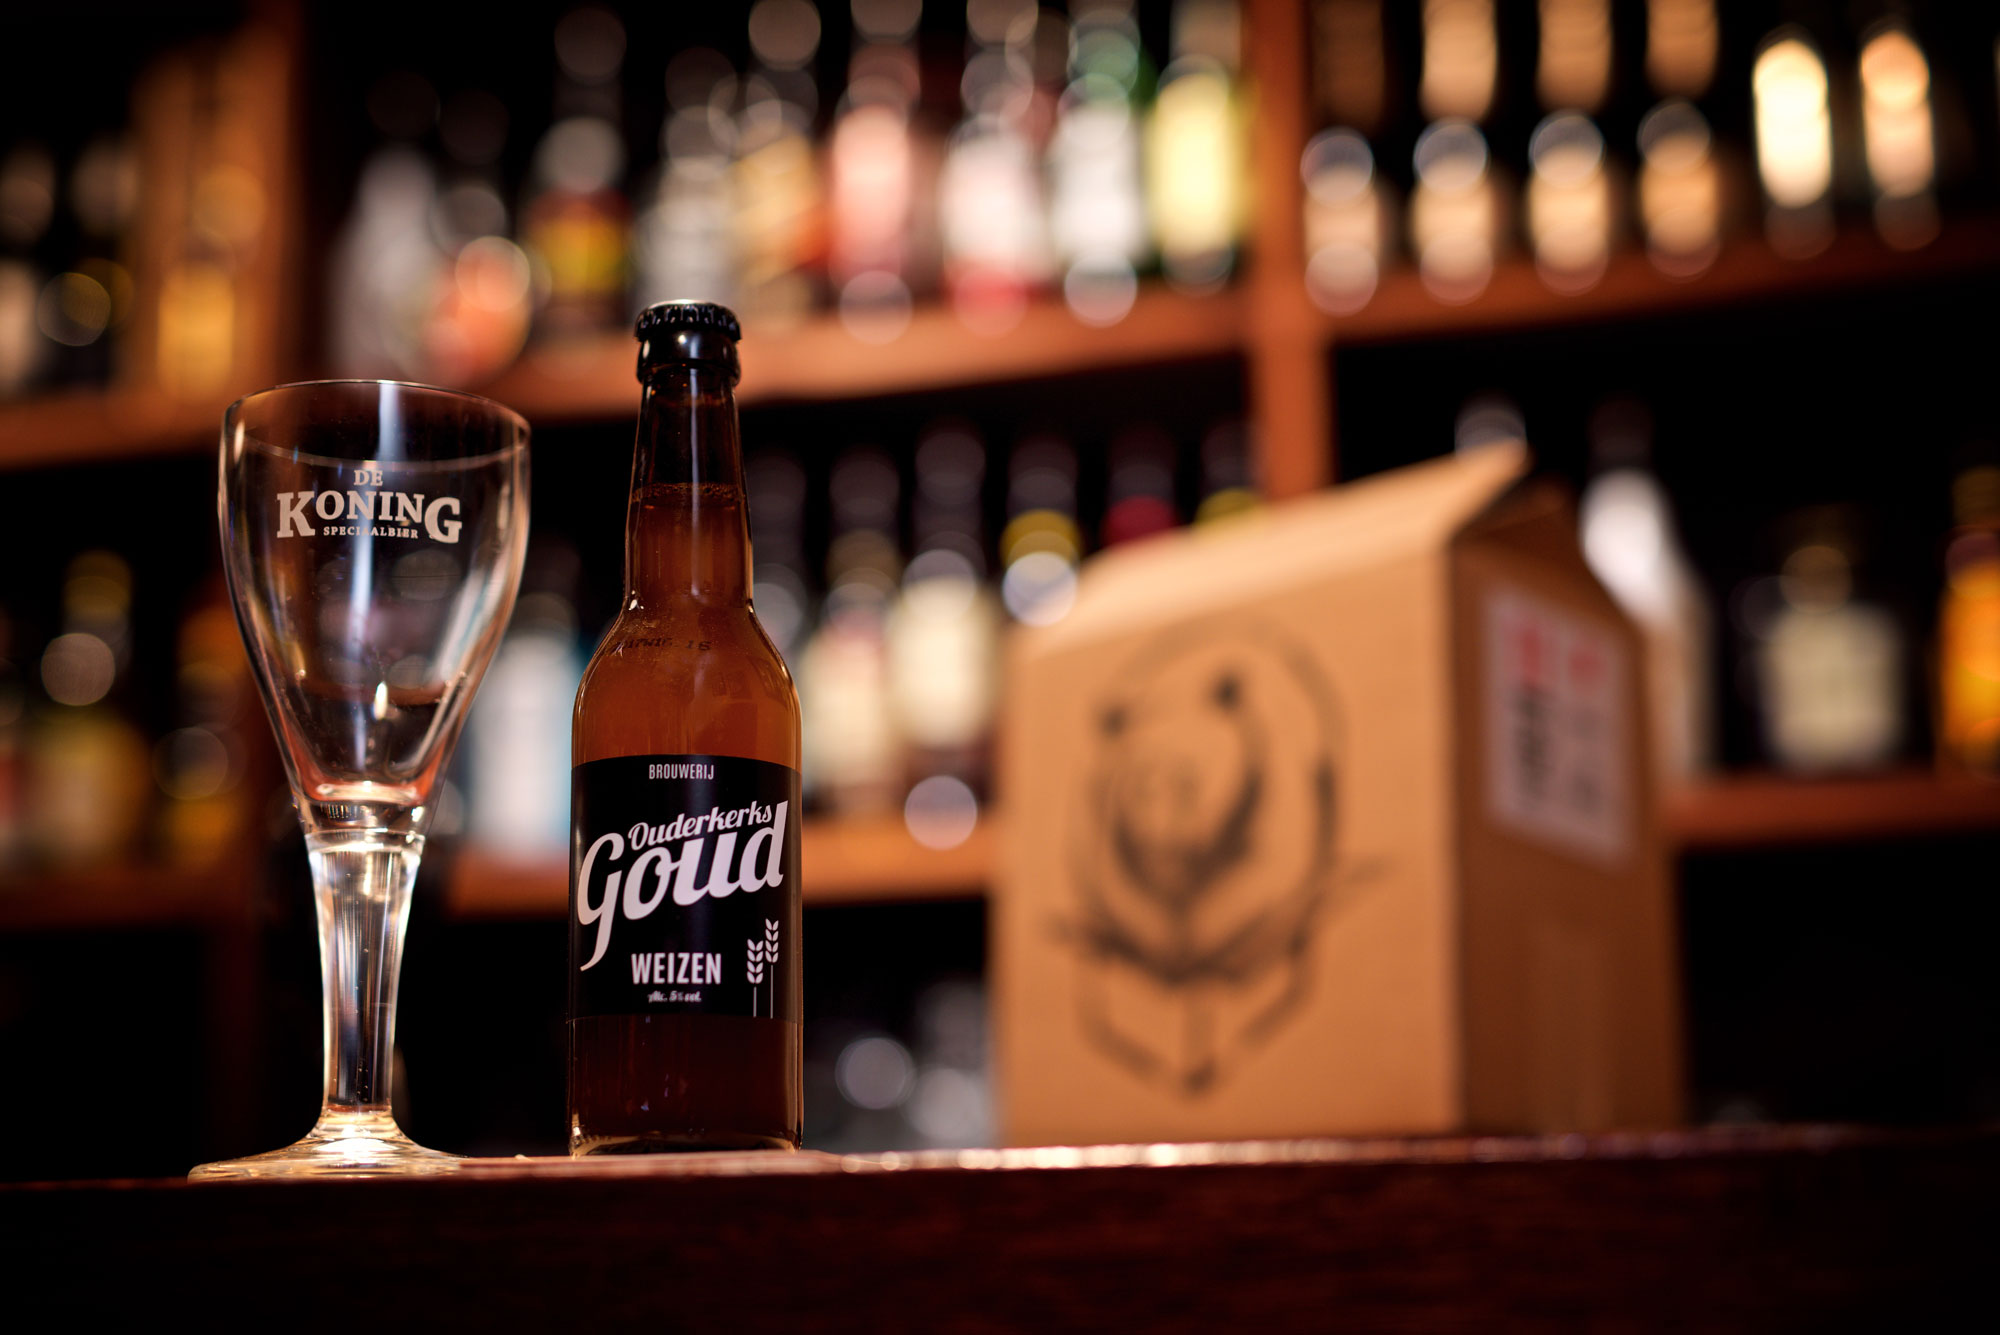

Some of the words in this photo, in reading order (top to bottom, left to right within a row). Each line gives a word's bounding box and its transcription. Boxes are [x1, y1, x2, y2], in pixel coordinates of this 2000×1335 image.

[353, 470, 383, 486] DE
[276, 490, 462, 543] KONING
[648, 763, 715, 780] BROUWERIJ
[627, 801, 773, 851] Ouderkerks
[577, 801, 788, 971] Goud
[631, 952, 722, 985] WEIZEN
